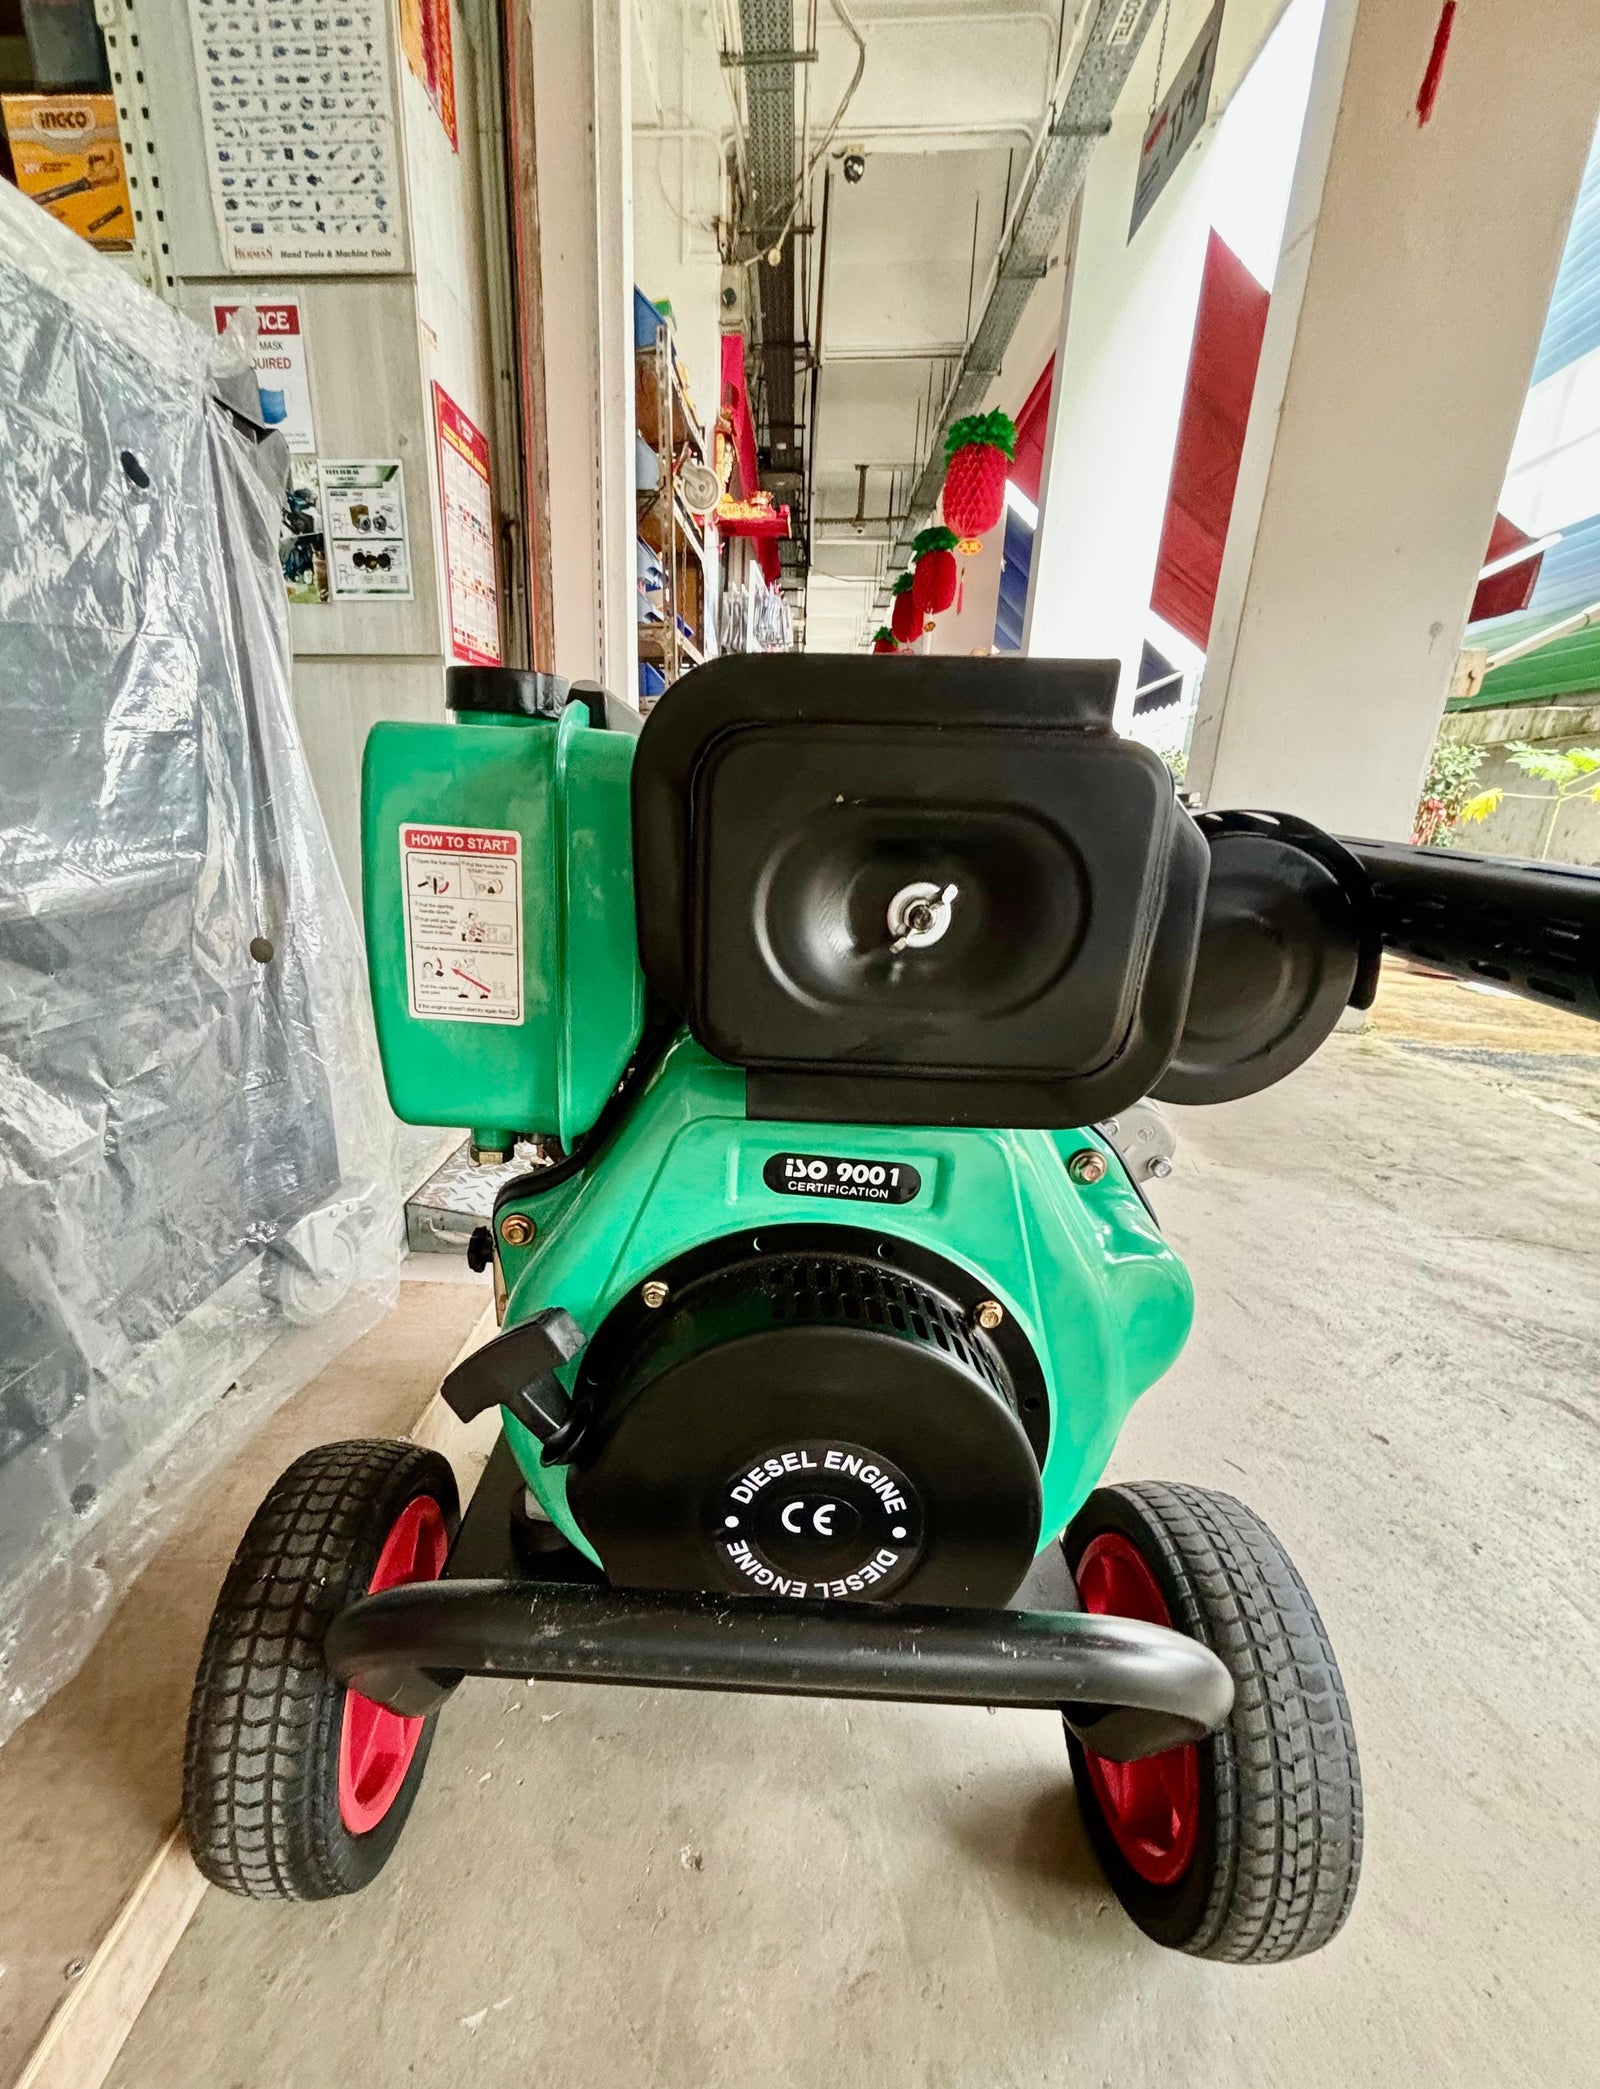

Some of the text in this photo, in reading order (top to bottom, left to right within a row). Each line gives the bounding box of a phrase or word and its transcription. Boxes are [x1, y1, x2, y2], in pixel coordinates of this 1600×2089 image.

[280, 250, 301, 258] Hand
[304, 250, 325, 258] Tools
[335, 249, 368, 258] Machine
[371, 249, 392, 257] Tools
[259, 341, 284, 350] MASK
[411, 834, 510, 851] HOW TO START
[836, 1163, 900, 1187] 9001
[787, 1181, 889, 1199] CERTIFICATION
[730, 1450, 907, 1515] DIESEL ENGINE
[781, 1501, 836, 1536] CE
[726, 1539, 899, 1598] DIESEL ENGINE
